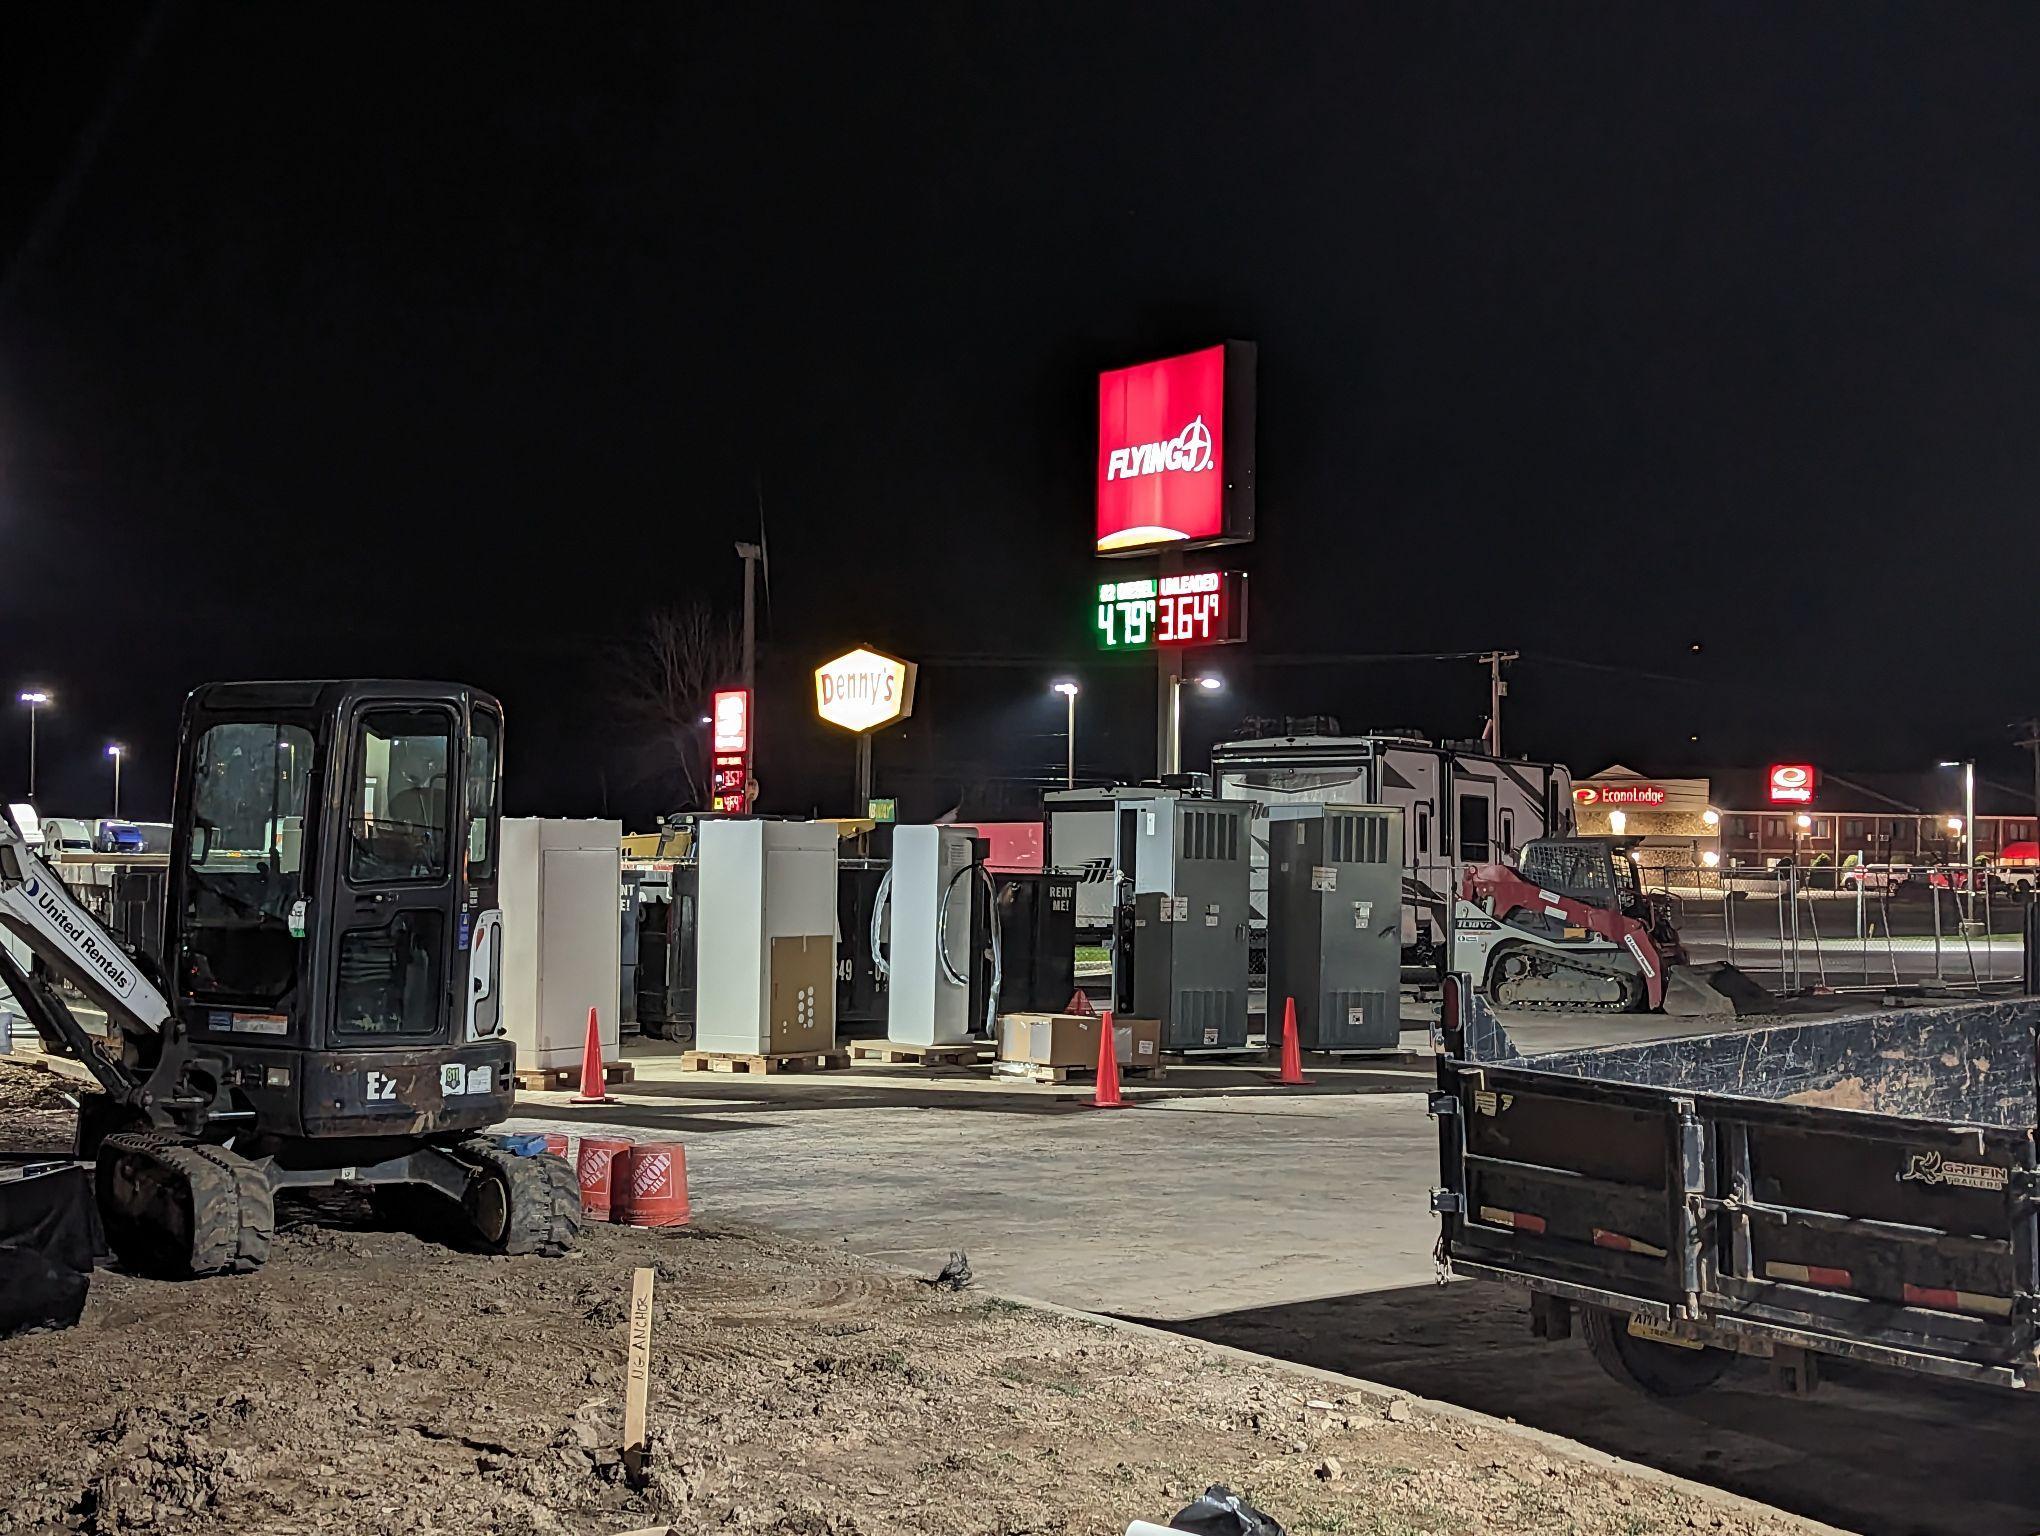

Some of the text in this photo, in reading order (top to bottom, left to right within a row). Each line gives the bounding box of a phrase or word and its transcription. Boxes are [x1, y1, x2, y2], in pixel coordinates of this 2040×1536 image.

[821, 667, 894, 705] Denny's
[869, 803, 893, 819] BWAY
[1049, 886, 1073, 898] RENT
[1052, 900, 1070, 912] ME!
[38, 892, 128, 988] United Rentals
[446, 1067, 460, 1081] 811
[1942, 1163, 2006, 1181] GRIFFIN
[1946, 1176, 2003, 1190] TRAILERS
[632, 1293, 648, 1351] ANCHOR
